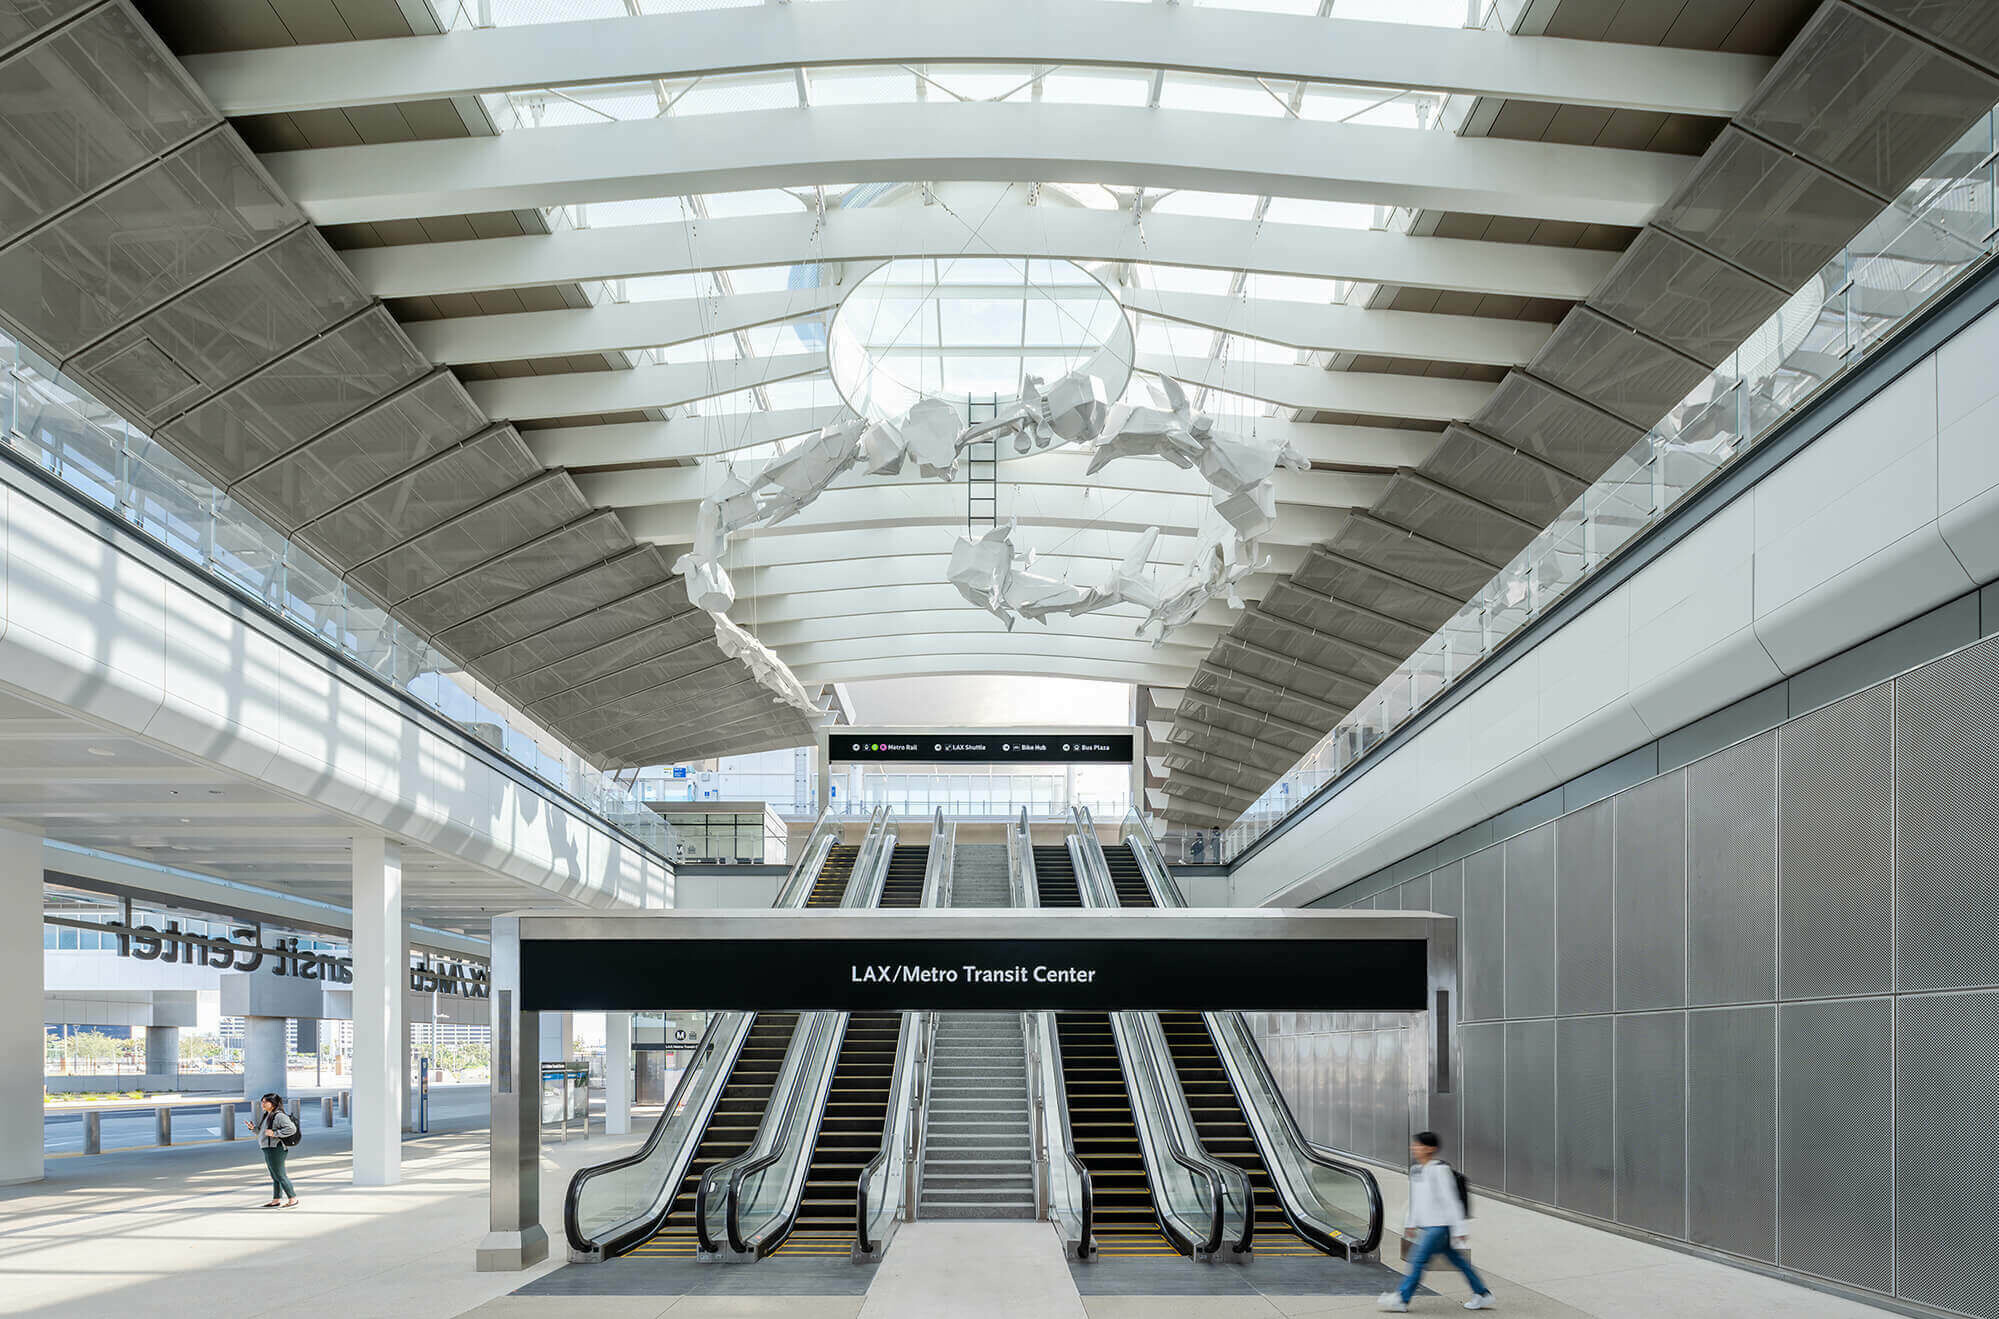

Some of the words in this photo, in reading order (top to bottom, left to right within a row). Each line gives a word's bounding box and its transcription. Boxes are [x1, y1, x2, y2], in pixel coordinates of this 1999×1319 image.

[888, 743, 905, 751] Metro
[906, 743, 918, 751] Rail
[952, 743, 964, 751] LAX
[965, 743, 986, 751] Shuttle
[1021, 743, 1034, 751] Bike
[1035, 743, 1047, 751] Hub
[1081, 743, 1092, 751] Bus
[1093, 743, 1110, 751] Plaza
[851, 965, 958, 983] LAX/Metro
[962, 965, 1028, 983] Transit
[1033, 965, 1096, 983] Center
